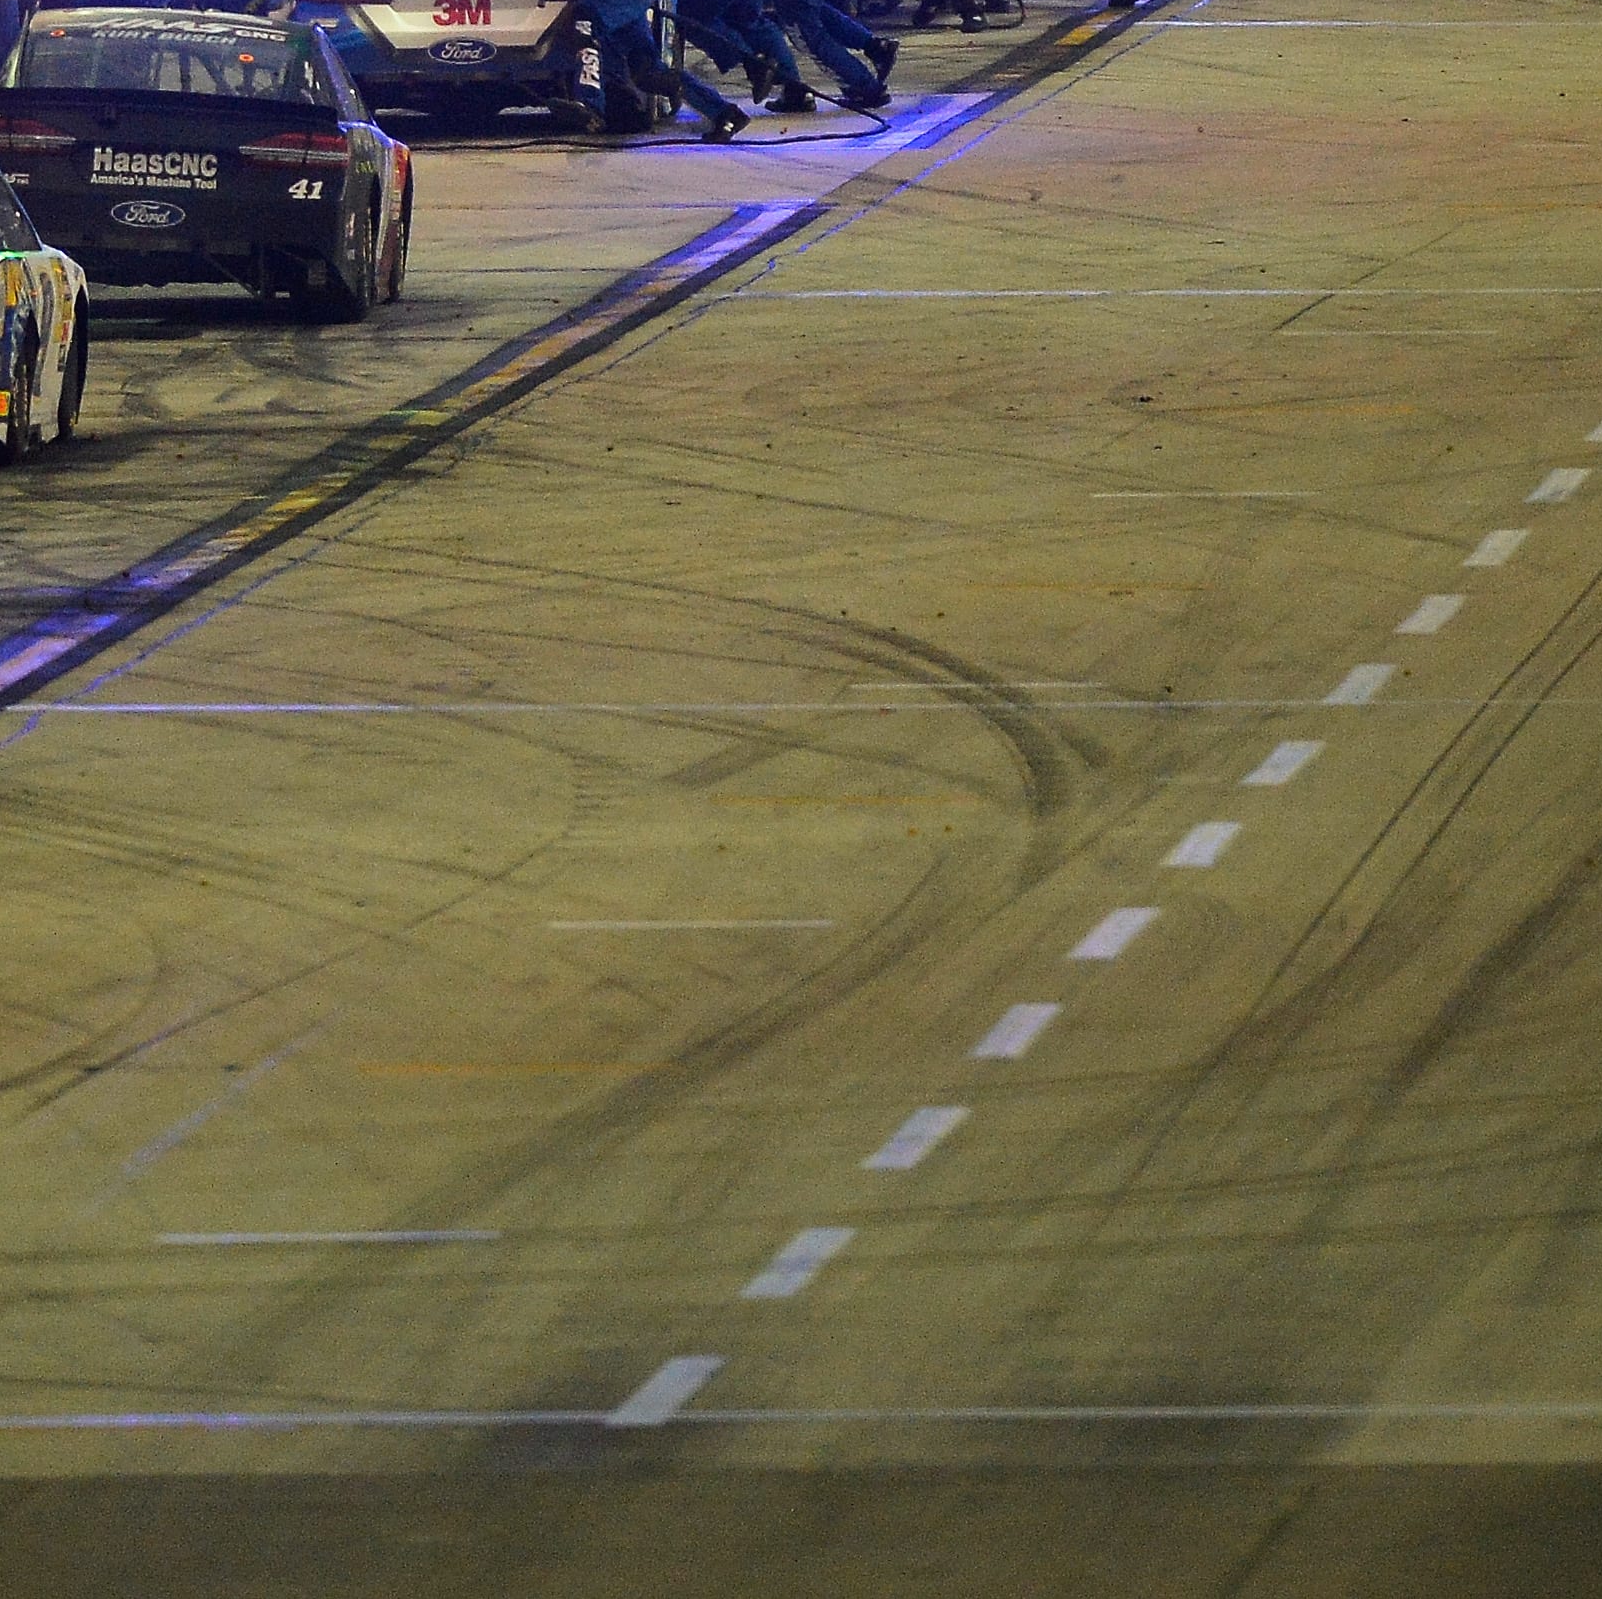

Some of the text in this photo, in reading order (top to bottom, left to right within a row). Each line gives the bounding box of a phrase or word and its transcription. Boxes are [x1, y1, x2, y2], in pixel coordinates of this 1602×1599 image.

[93, 146, 218, 178] HaasCNC
[90, 173, 144, 187] America's
[194, 177, 218, 190] Tool
[288, 178, 325, 200] 41
